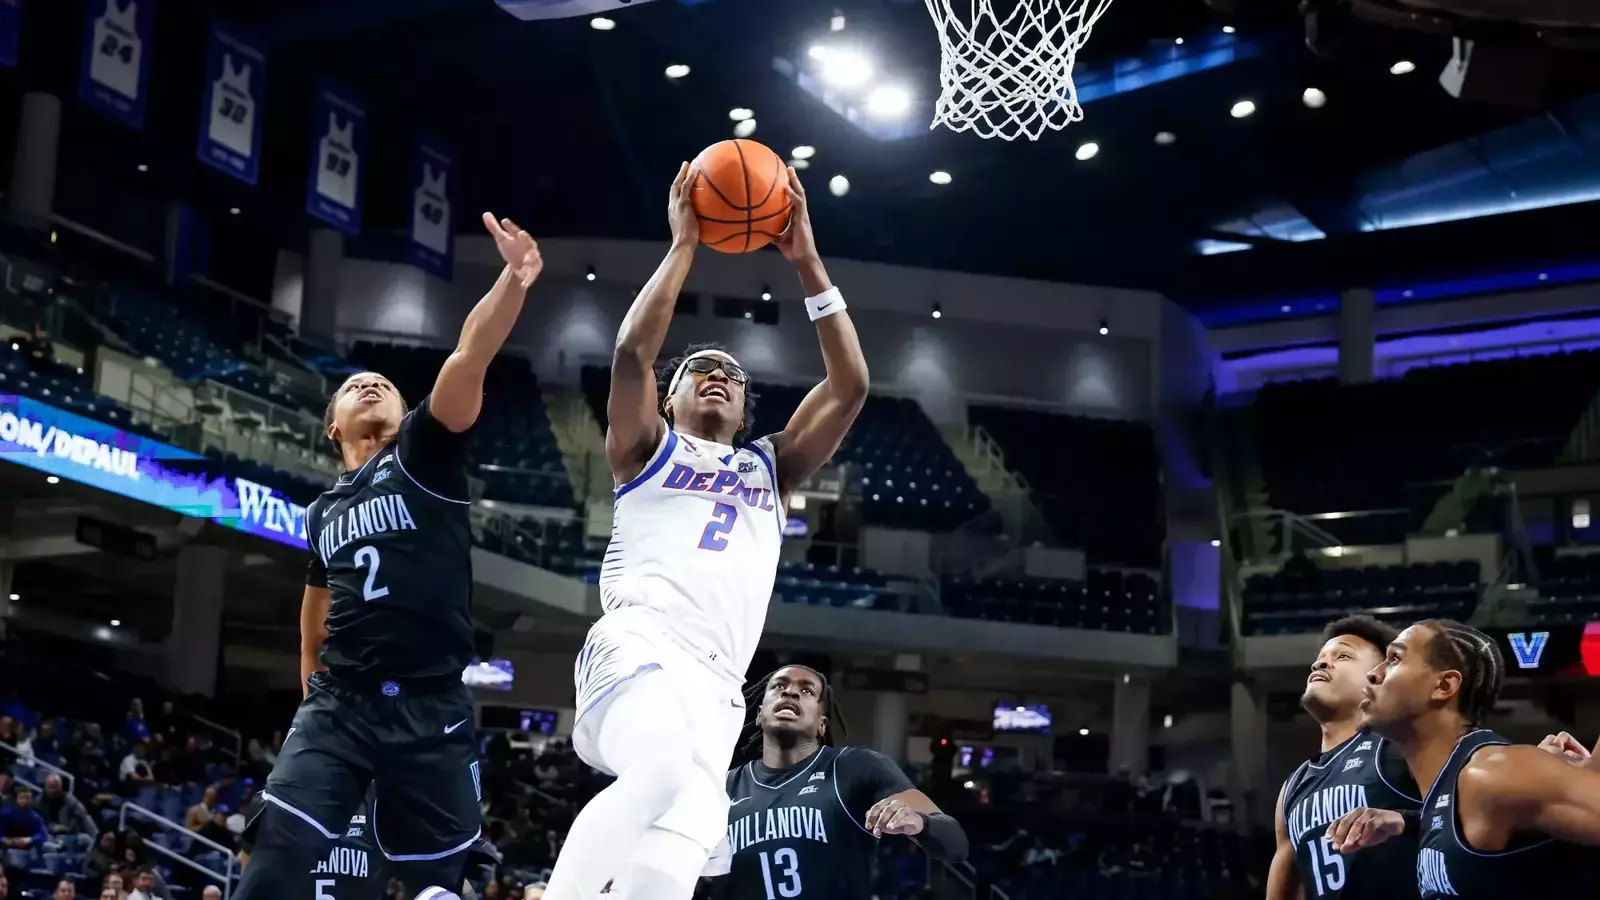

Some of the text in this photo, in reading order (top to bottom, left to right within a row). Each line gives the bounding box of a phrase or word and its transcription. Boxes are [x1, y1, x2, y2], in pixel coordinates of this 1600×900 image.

[319, 494, 417, 568] VILLANOVA
[697, 502, 738, 551] 2
[354, 545, 389, 601] 2
[1507, 632, 1550, 669] V
[728, 806, 828, 855] VILLANOVA
[310, 847, 368, 877] ANOVA
[759, 847, 802, 900] 13
[1307, 835, 1345, 896] 15
